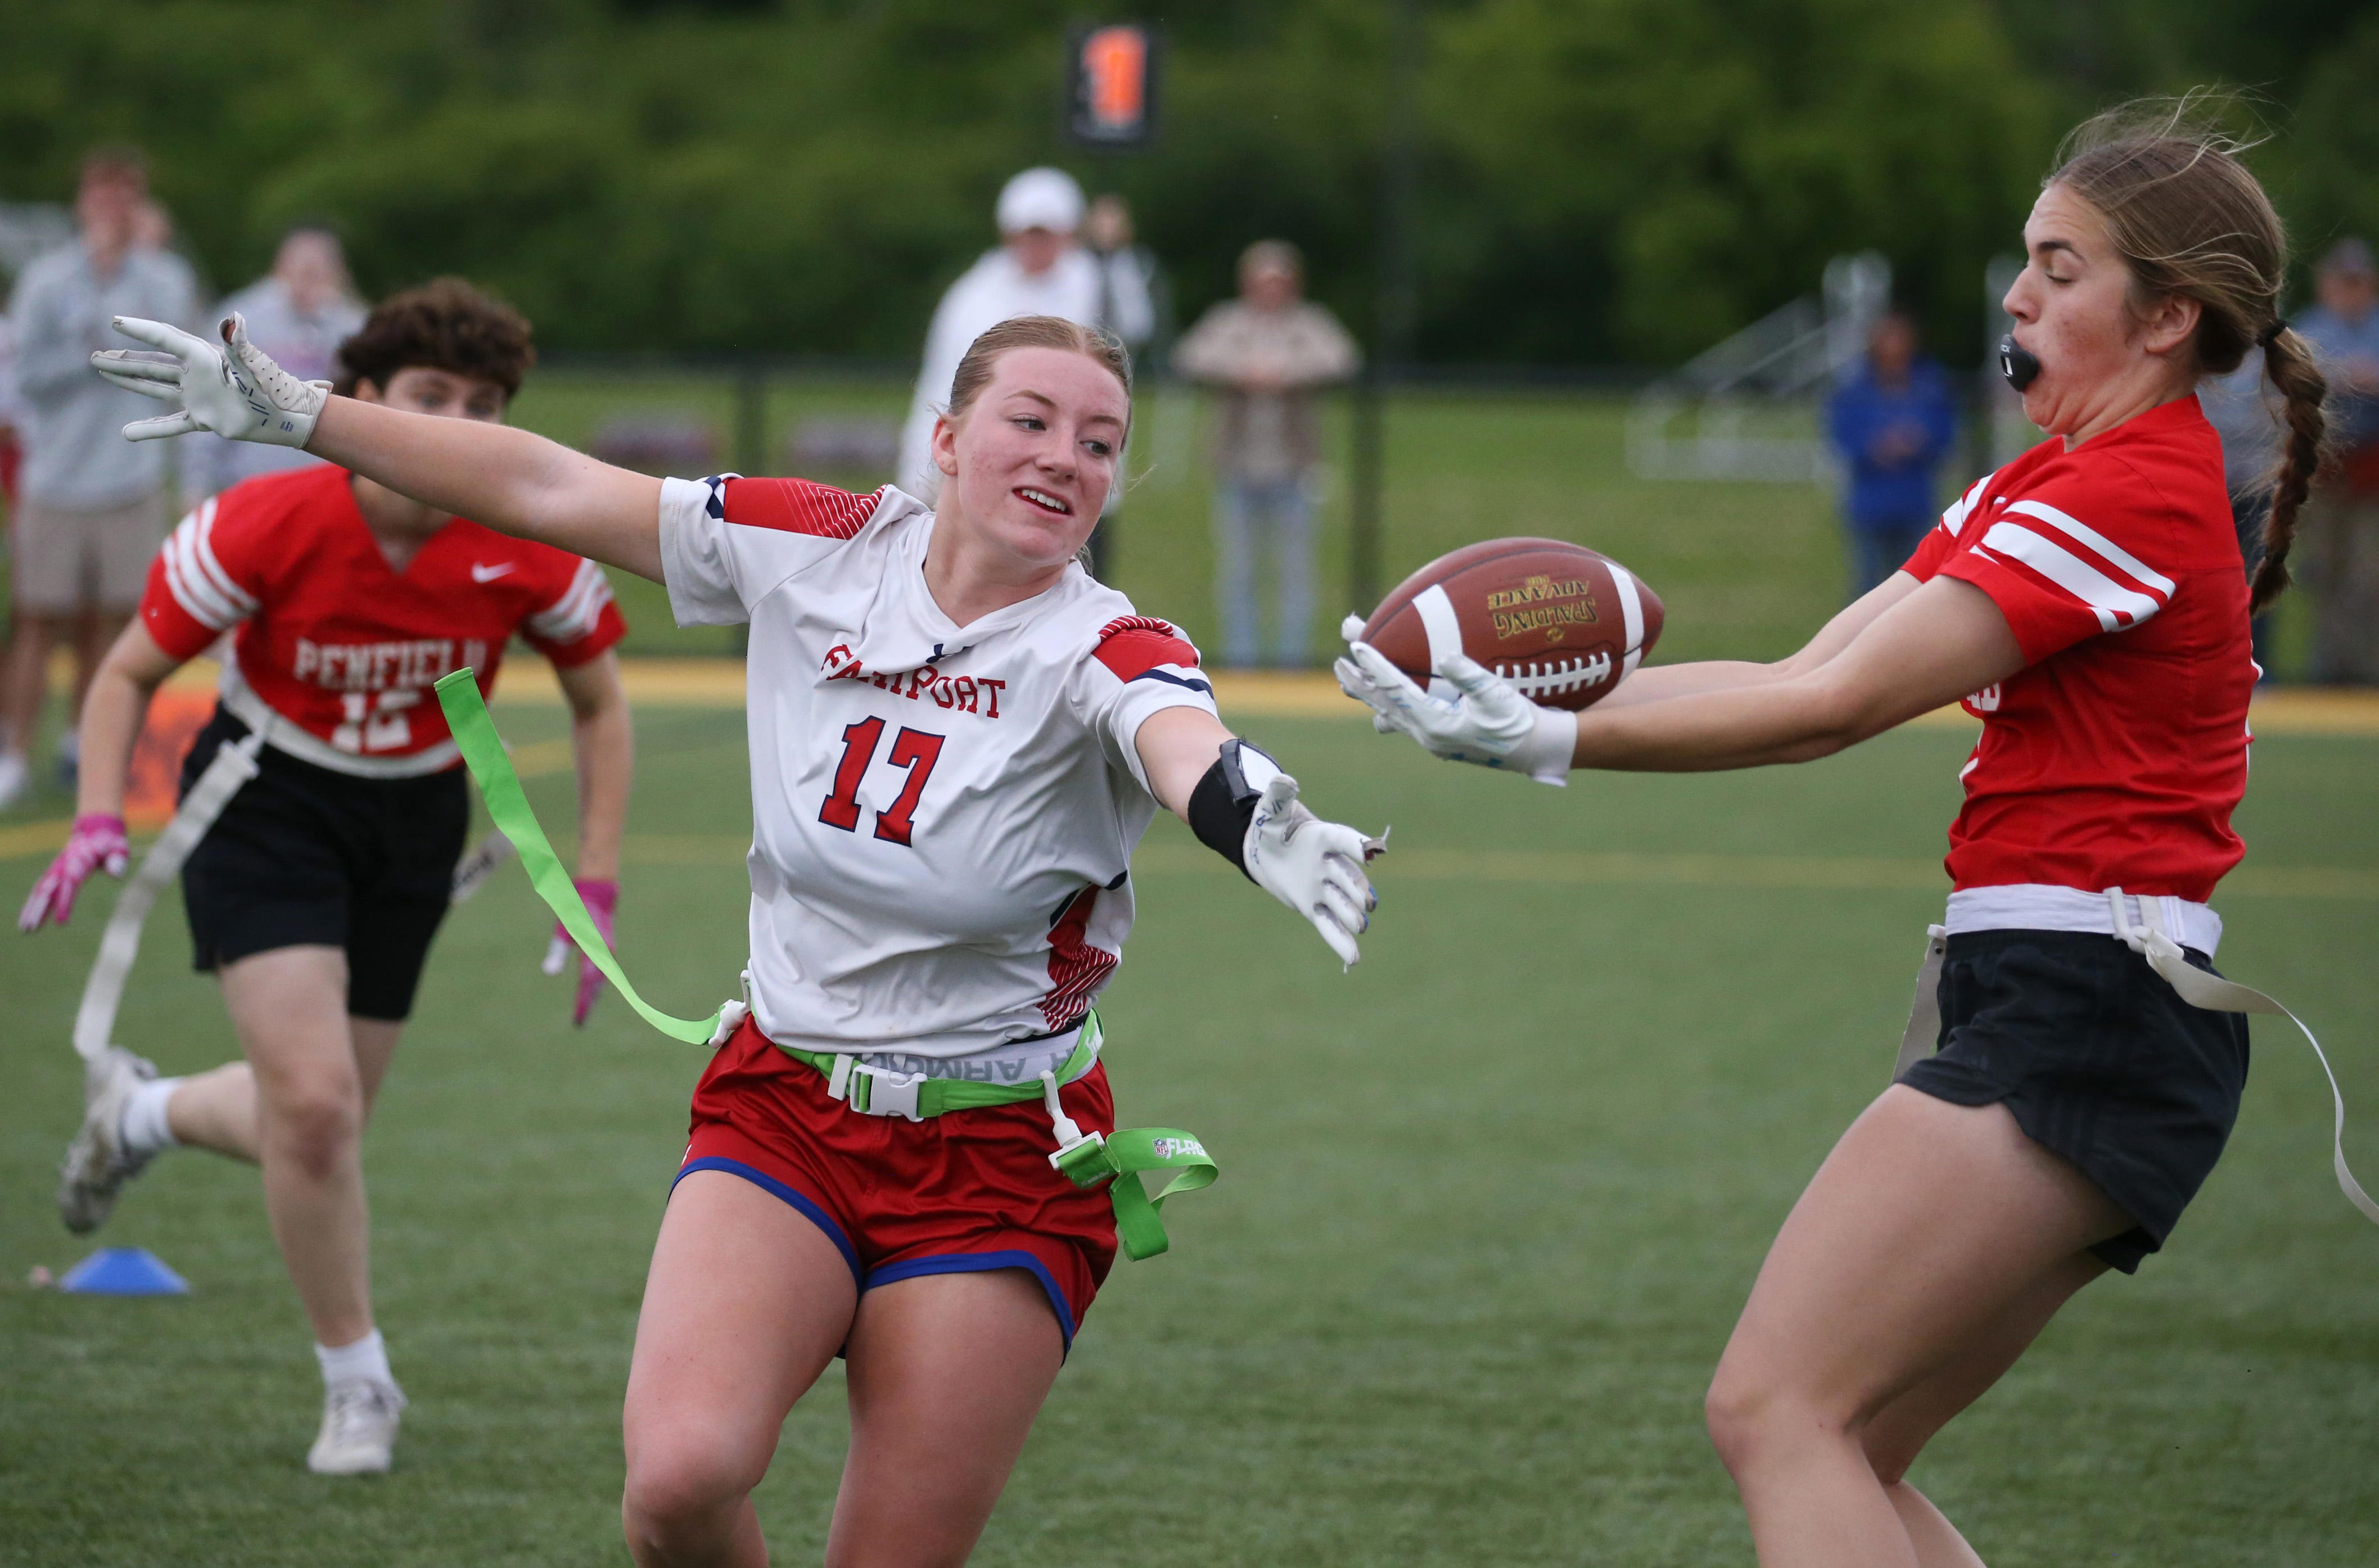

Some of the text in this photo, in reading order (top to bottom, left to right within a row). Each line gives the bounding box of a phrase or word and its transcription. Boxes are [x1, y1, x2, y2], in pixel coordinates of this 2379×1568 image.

[1487, 580, 1590, 611] ADVANCE
[1494, 599, 1597, 639] SPALDING
[820, 644, 1005, 719] FAPORT
[818, 715, 946, 848] 17
[1156, 1137, 1207, 1160] NFL FLAG
